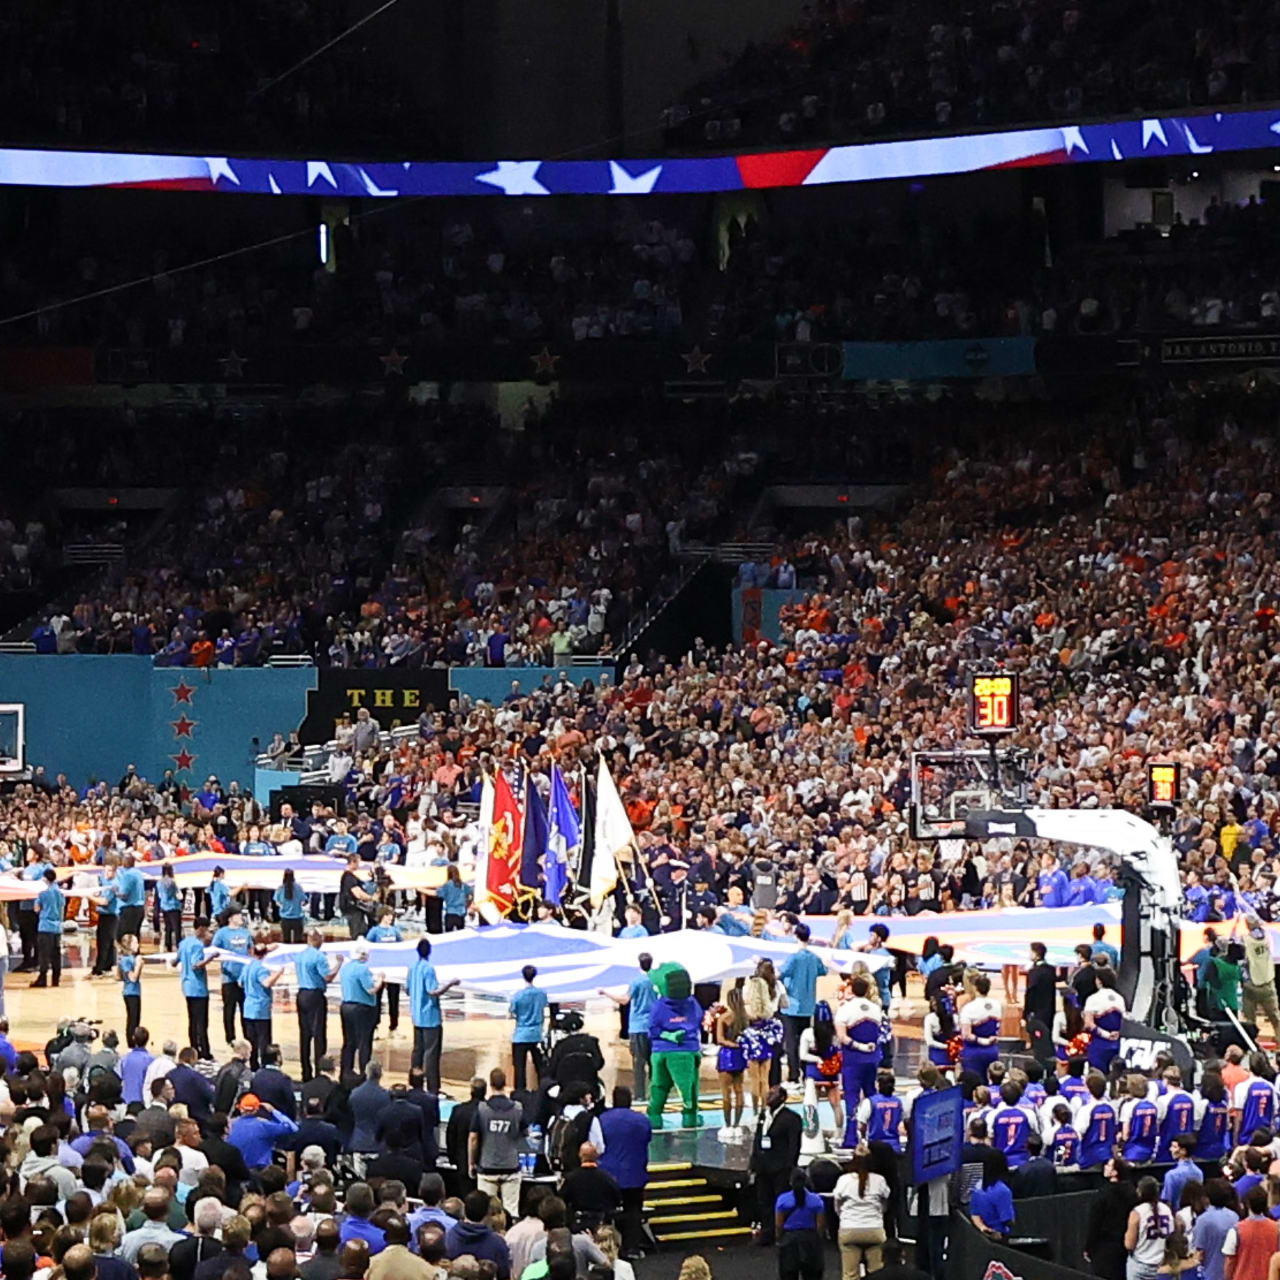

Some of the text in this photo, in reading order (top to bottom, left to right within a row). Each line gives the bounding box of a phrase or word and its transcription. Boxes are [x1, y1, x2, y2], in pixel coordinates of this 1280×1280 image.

[345, 689, 420, 708] THE
[978, 696, 1008, 726] 30
[489, 1119, 513, 1133] 677
[1146, 1215, 1170, 1240] 25
